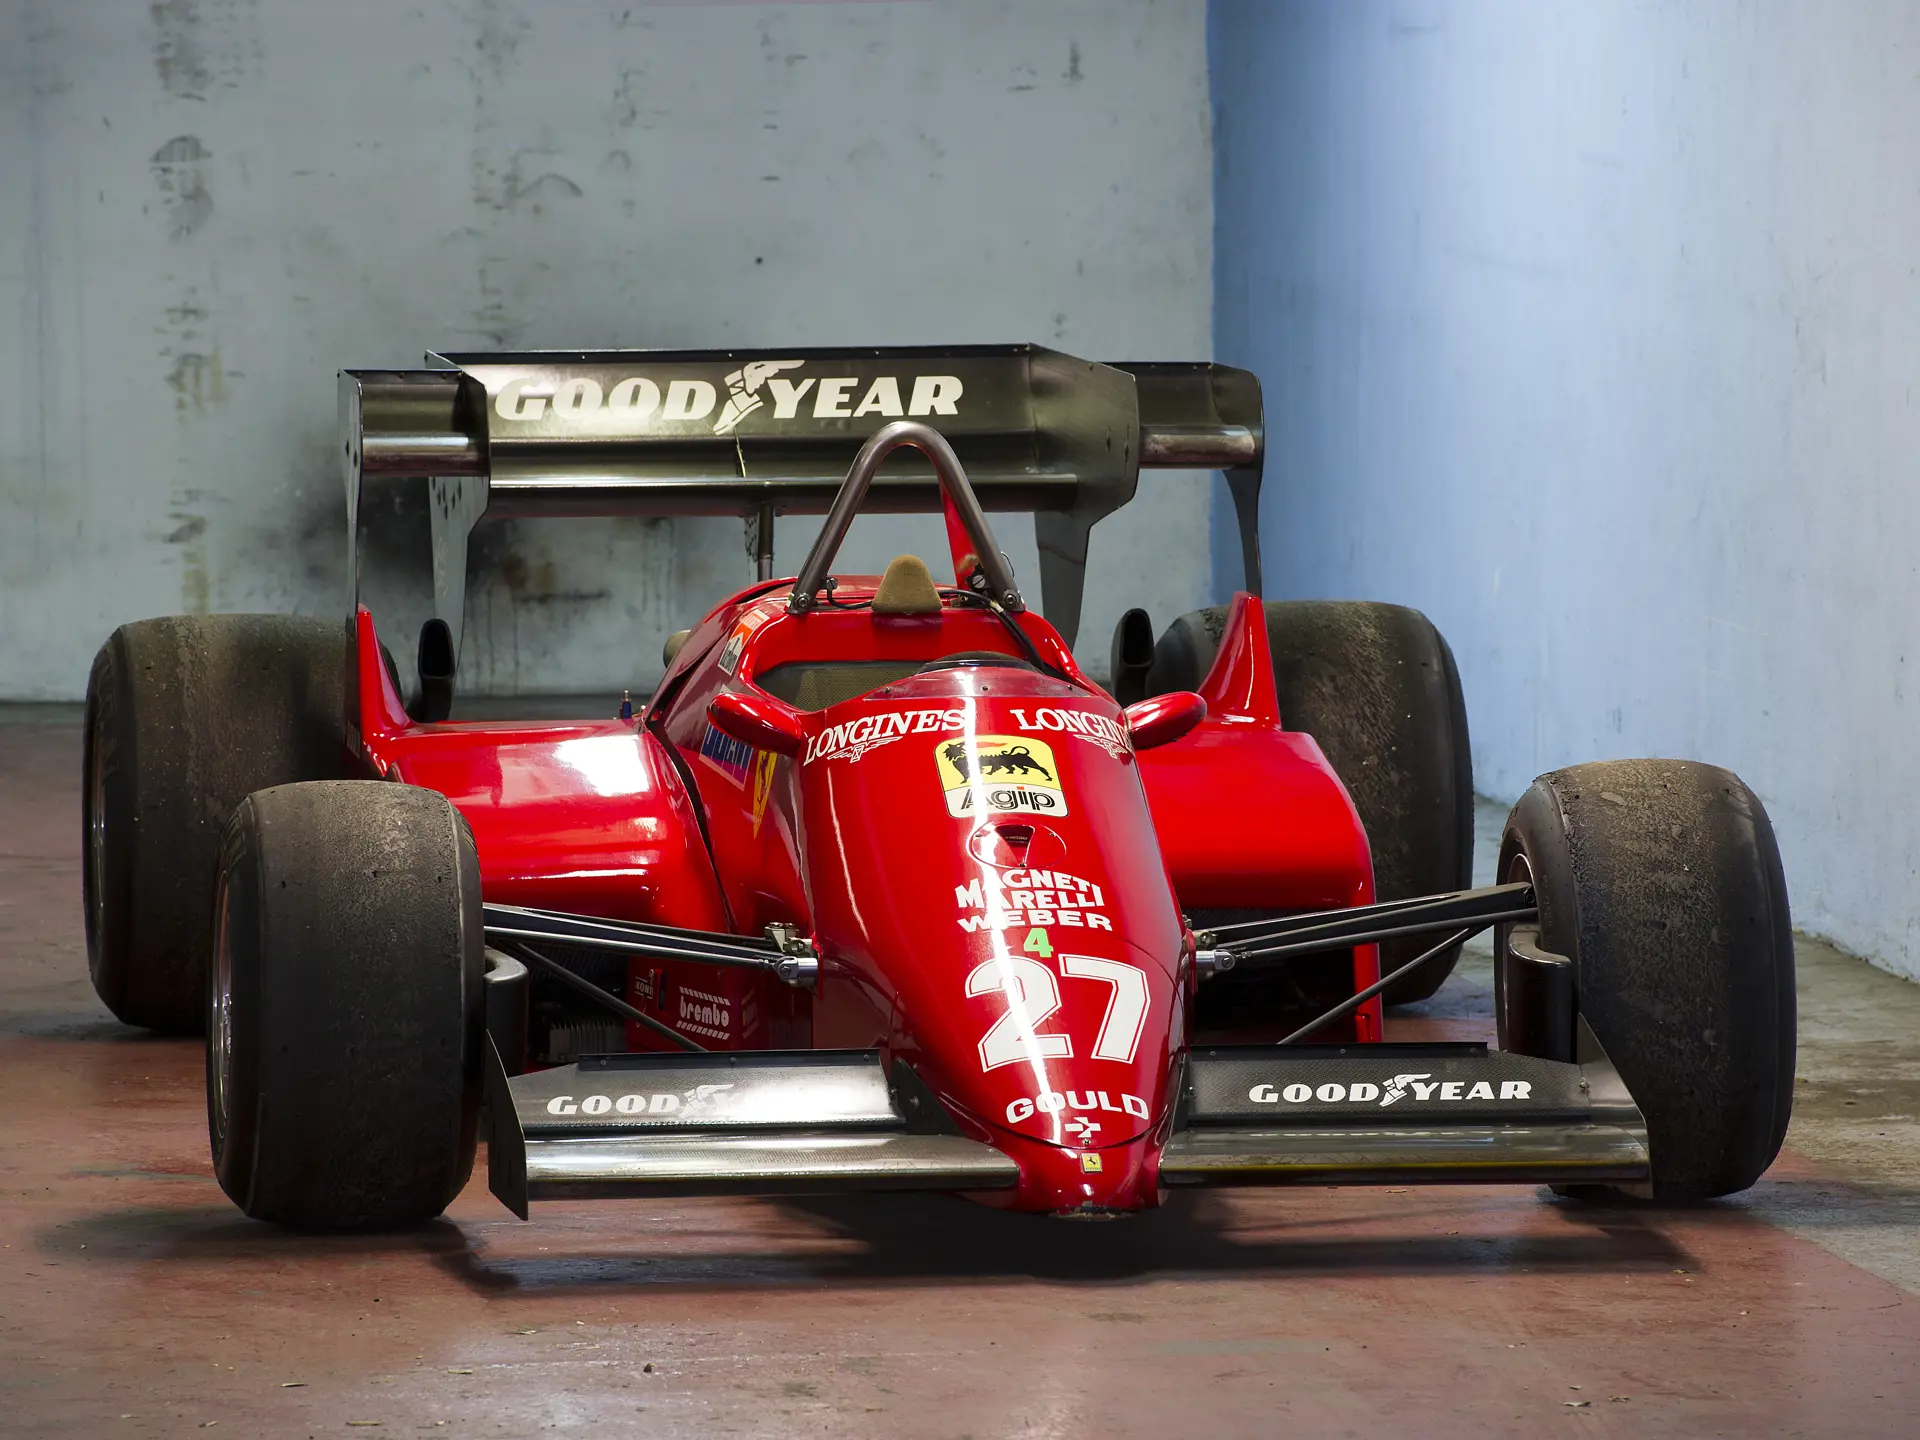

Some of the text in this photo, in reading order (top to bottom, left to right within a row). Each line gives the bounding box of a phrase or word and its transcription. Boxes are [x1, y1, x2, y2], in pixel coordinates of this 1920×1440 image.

[803, 709, 969, 766] LONGINES
[961, 786, 1056, 811] Agip
[957, 909, 1113, 933] WEBER
[1023, 927, 1054, 958] 4
[680, 995, 730, 1028] brembo
[965, 953, 1151, 1073] 27
[1005, 1090, 1150, 1123] GOULD
